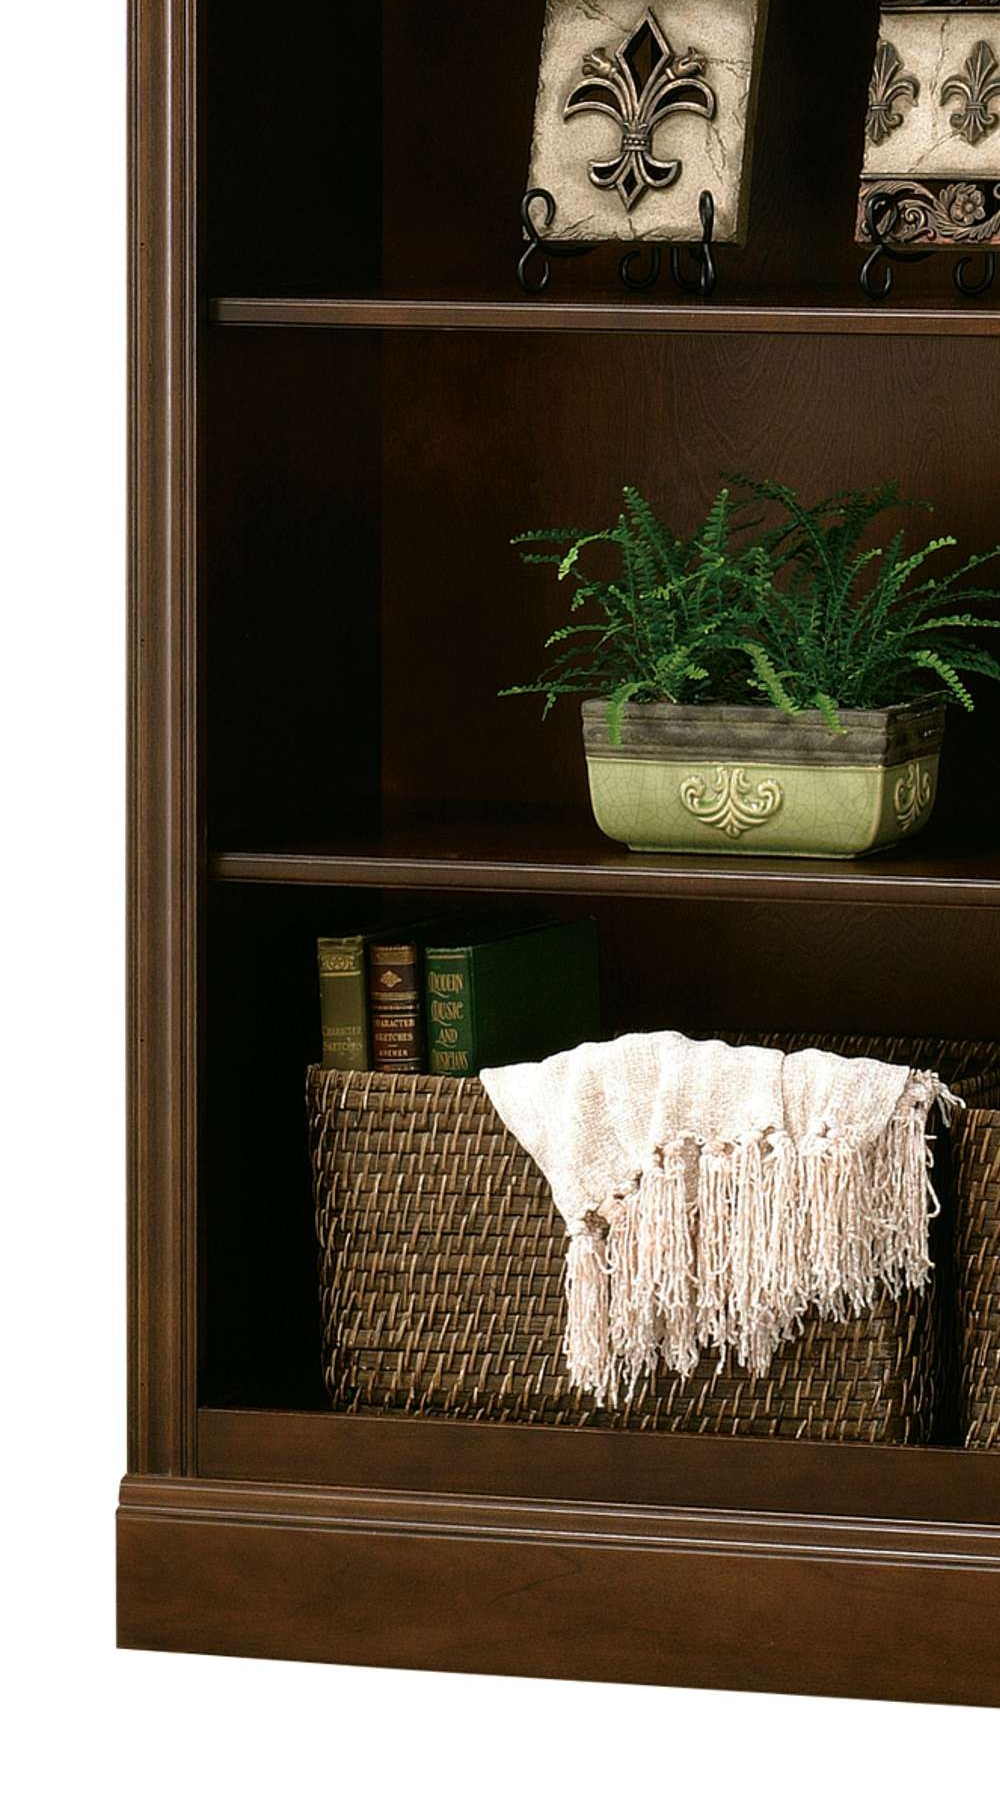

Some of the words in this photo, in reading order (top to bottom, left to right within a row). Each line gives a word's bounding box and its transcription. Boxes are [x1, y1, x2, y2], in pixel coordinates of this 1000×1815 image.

[428, 971, 464, 998] MODERN
[431, 1000, 464, 1026] MUSIC
[435, 1027, 458, 1049] AND
